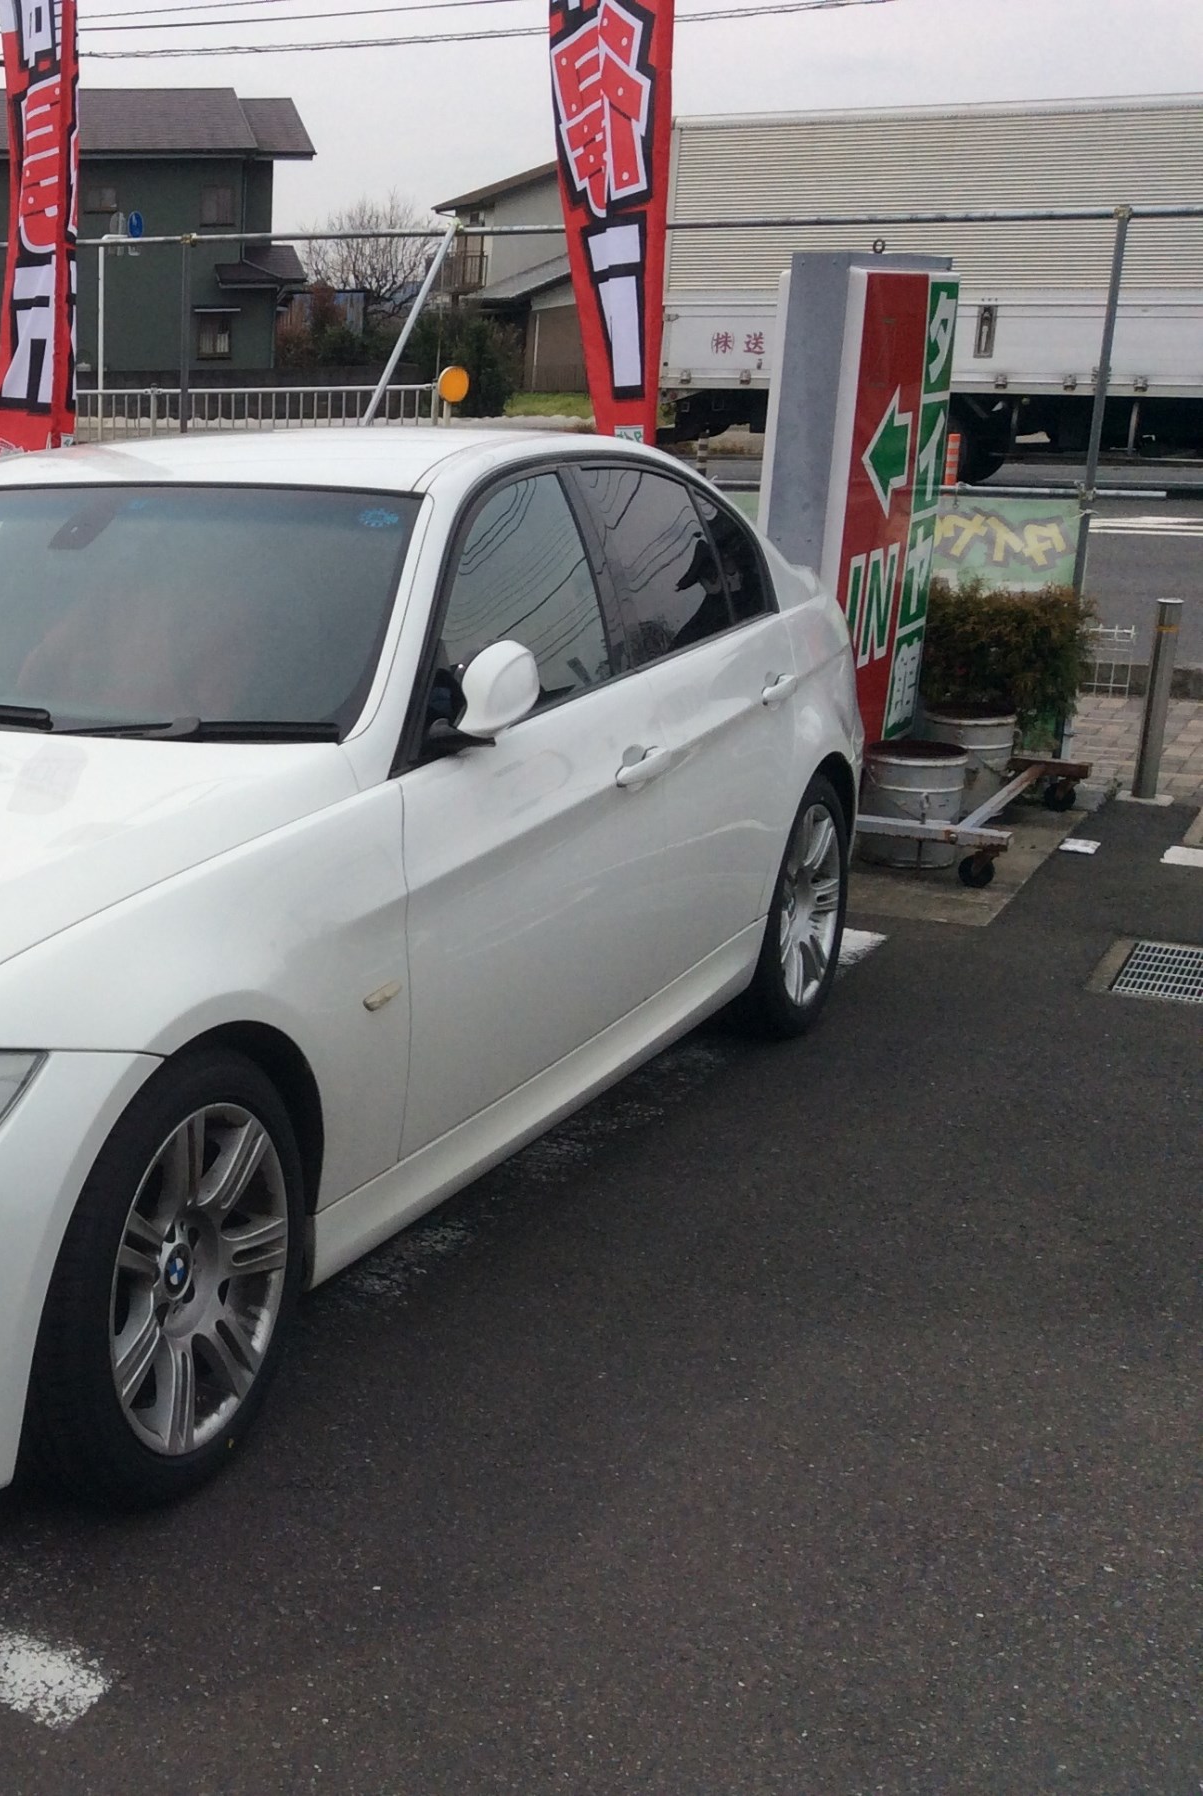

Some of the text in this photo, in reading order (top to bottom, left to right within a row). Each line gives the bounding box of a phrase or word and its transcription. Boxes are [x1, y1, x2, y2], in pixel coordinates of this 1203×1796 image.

[846, 542, 900, 669] IN
[887, 291, 957, 728] タイヤ館
